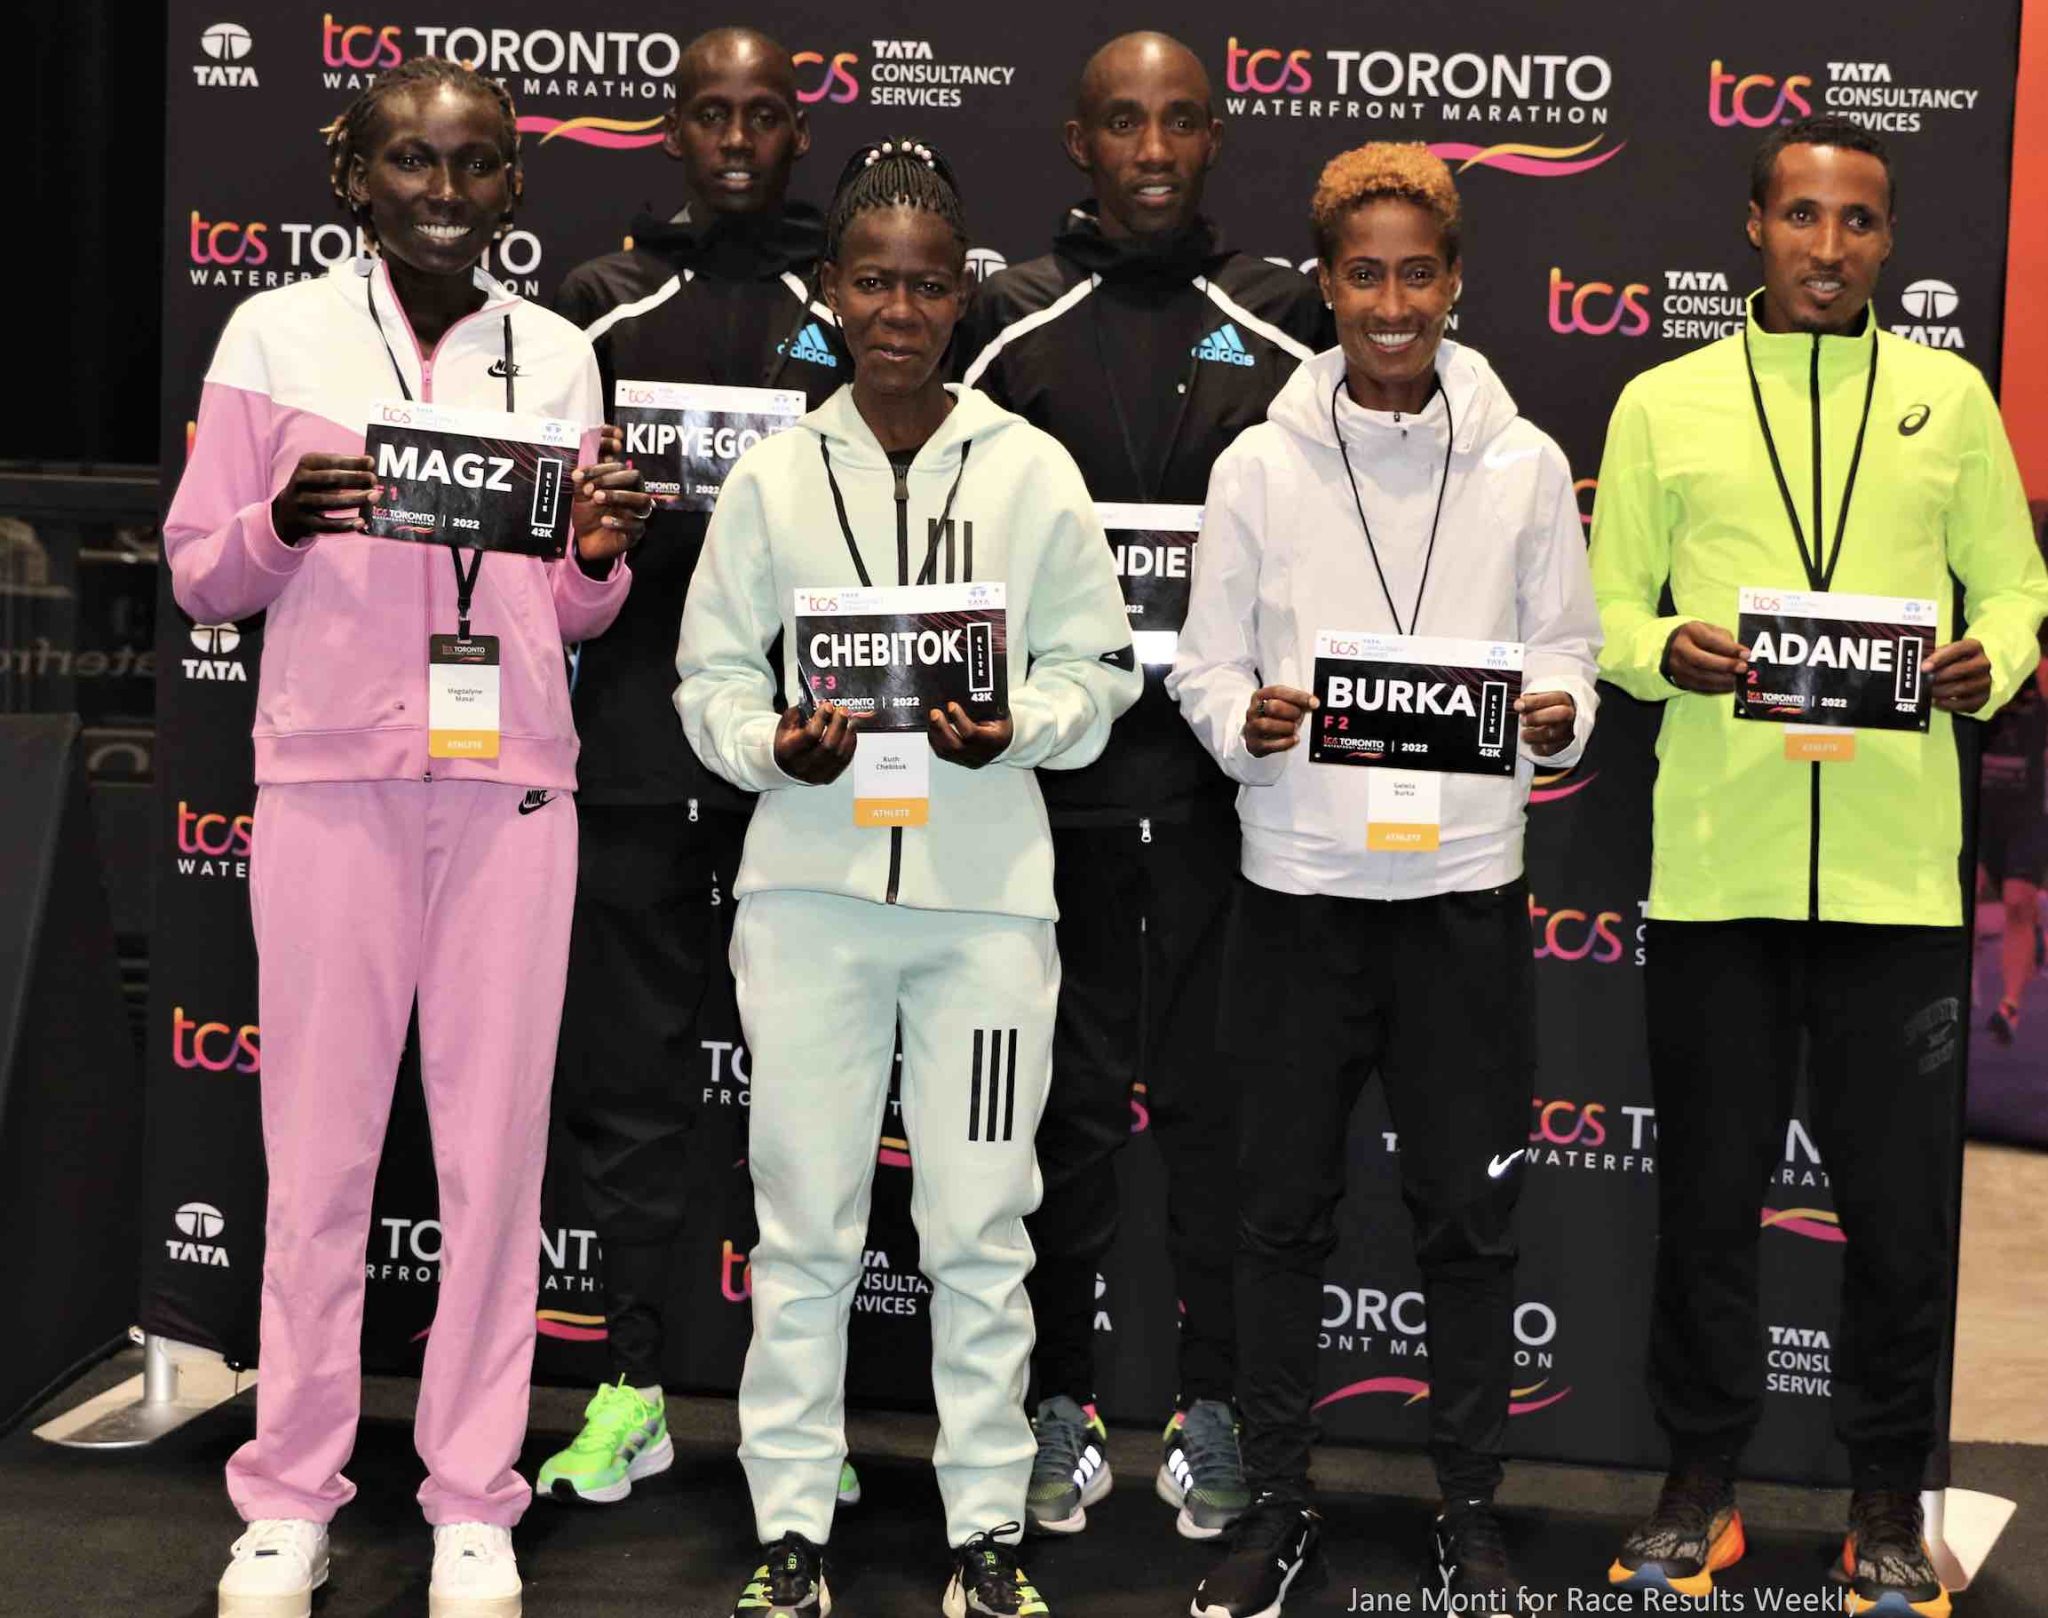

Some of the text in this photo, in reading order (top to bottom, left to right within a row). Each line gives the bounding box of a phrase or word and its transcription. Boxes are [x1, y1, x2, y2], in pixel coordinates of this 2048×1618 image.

[323, 13, 680, 77] tcs TORONTO
[872, 41, 933, 60] TATA
[193, 66, 258, 88] TATA
[792, 52, 858, 103] cs
[871, 64, 1015, 85] CONSULTANCY
[1226, 37, 1612, 101] tcs TORONTO
[1827, 62, 1892, 82] TATA
[524, 78, 677, 99] MARATHON
[871, 87, 961, 107] SERVICES
[1709, 59, 1812, 128] tcs
[1825, 87, 1978, 109] CONSULTANCY
[1226, 98, 1608, 124] WATERFRONT MARATHON
[190, 211, 268, 265] tcs
[1664, 271, 1729, 292] TATA
[1549, 267, 1650, 337] tcs
[1663, 295, 1746, 317] CONSUL
[377, 443, 516, 492] MAGZ
[541, 472, 552, 512] ELITE
[644, 482, 719, 494] ORONTO 2022
[390, 509, 435, 523] TORONTO
[452, 518, 480, 529] 2022
[531, 528, 552, 538] 42K
[1115, 545, 1187, 578] NDIE
[809, 595, 838, 612] tcs
[1124, 604, 1144, 614] 022
[454, 646, 486, 654] TORONTO
[809, 628, 965, 668] CHEBITOK
[976, 635, 984, 677] ELITE
[1330, 637, 1358, 656] tcs
[1749, 631, 1893, 673] ADANE
[183, 659, 247, 682] TATA
[1747, 670, 1758, 684] 2
[1904, 650, 1913, 689] ELITE
[811, 675, 836, 690] F 3
[830, 697, 875, 707] TORONTO
[892, 697, 920, 706] 2022
[971, 692, 993, 702] 42K
[1327, 675, 1476, 718] BURKA
[1762, 692, 1805, 704] TORONTO
[1821, 697, 1848, 708] 2022
[1895, 702, 1917, 713] 42K
[1324, 715, 1349, 730] F 2
[1488, 694, 1497, 733] ELITE
[1340, 737, 1385, 749] TORONTO
[1401, 743, 1428, 753] 2022
[1479, 748, 1501, 758] 42K
[525, 790, 548, 805] NIKE
[177, 801, 253, 856] tcs
[172, 1006, 261, 1073] tcs
[166, 1240, 230, 1267] TATA
[1768, 1326, 1831, 1349] TATA
